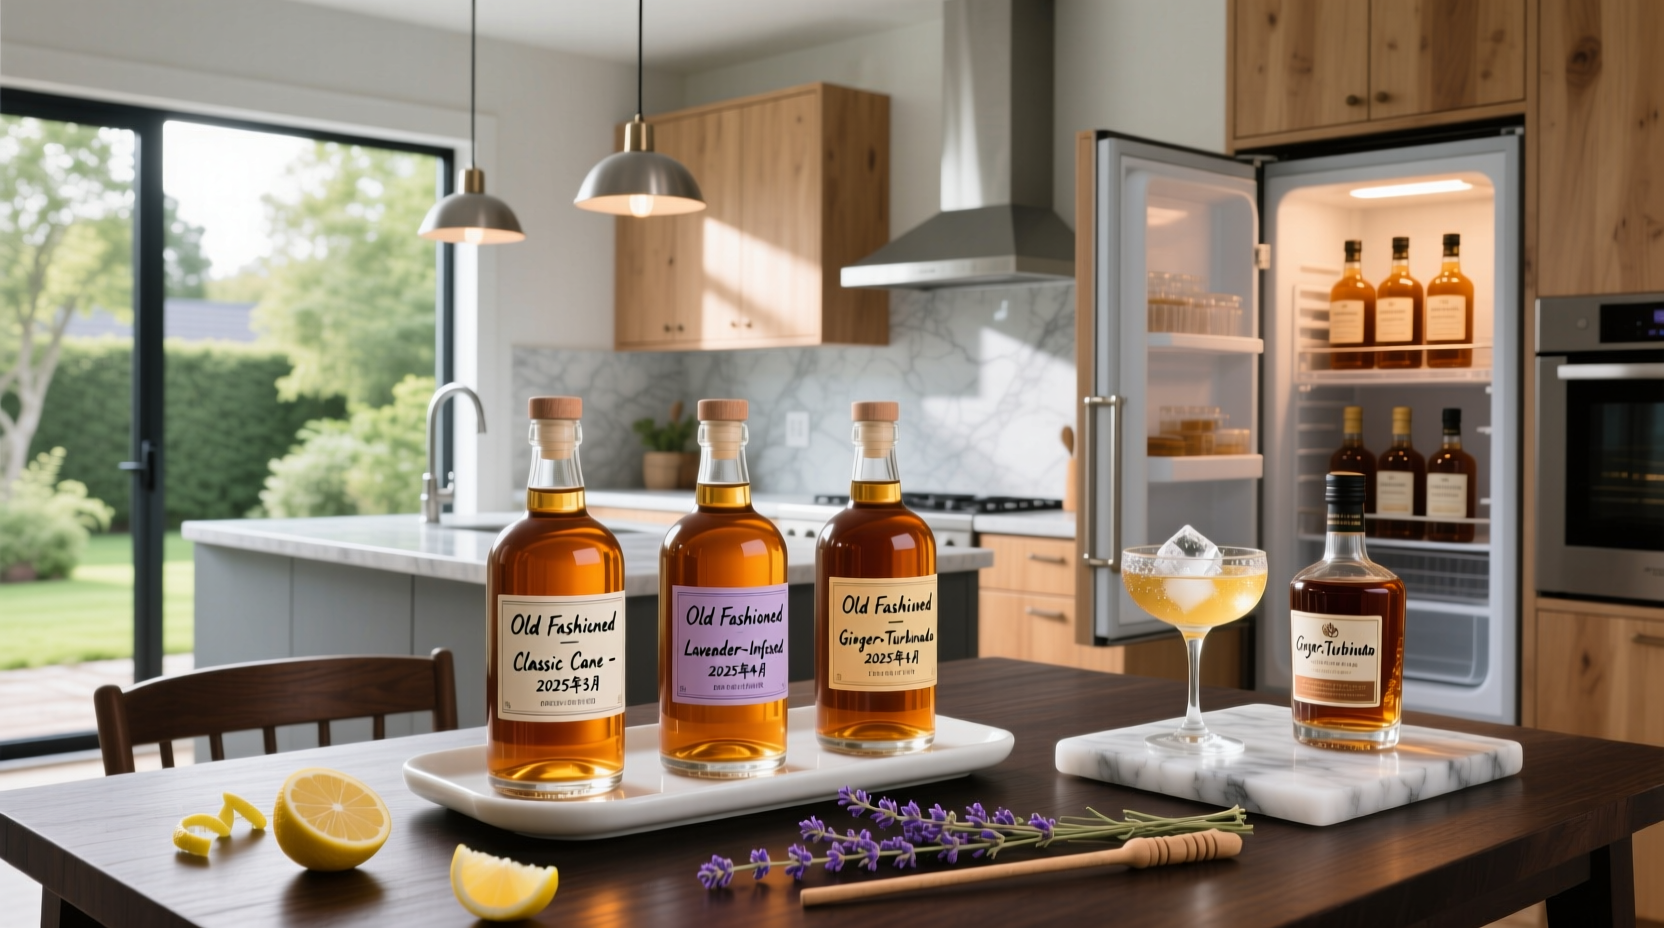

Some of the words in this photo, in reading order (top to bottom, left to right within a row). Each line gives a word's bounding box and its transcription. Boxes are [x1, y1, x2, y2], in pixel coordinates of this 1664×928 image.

[843, 595, 869, 614] Old
[511, 614, 541, 635] Old
[686, 605, 715, 625] Old
[720, 604, 783, 626] Fashioned
[514, 652, 563, 671] Classic
[571, 651, 603, 670] Cane
[708, 663, 765, 679] 2025年4月
[536, 676, 599, 693] 2025年3月
